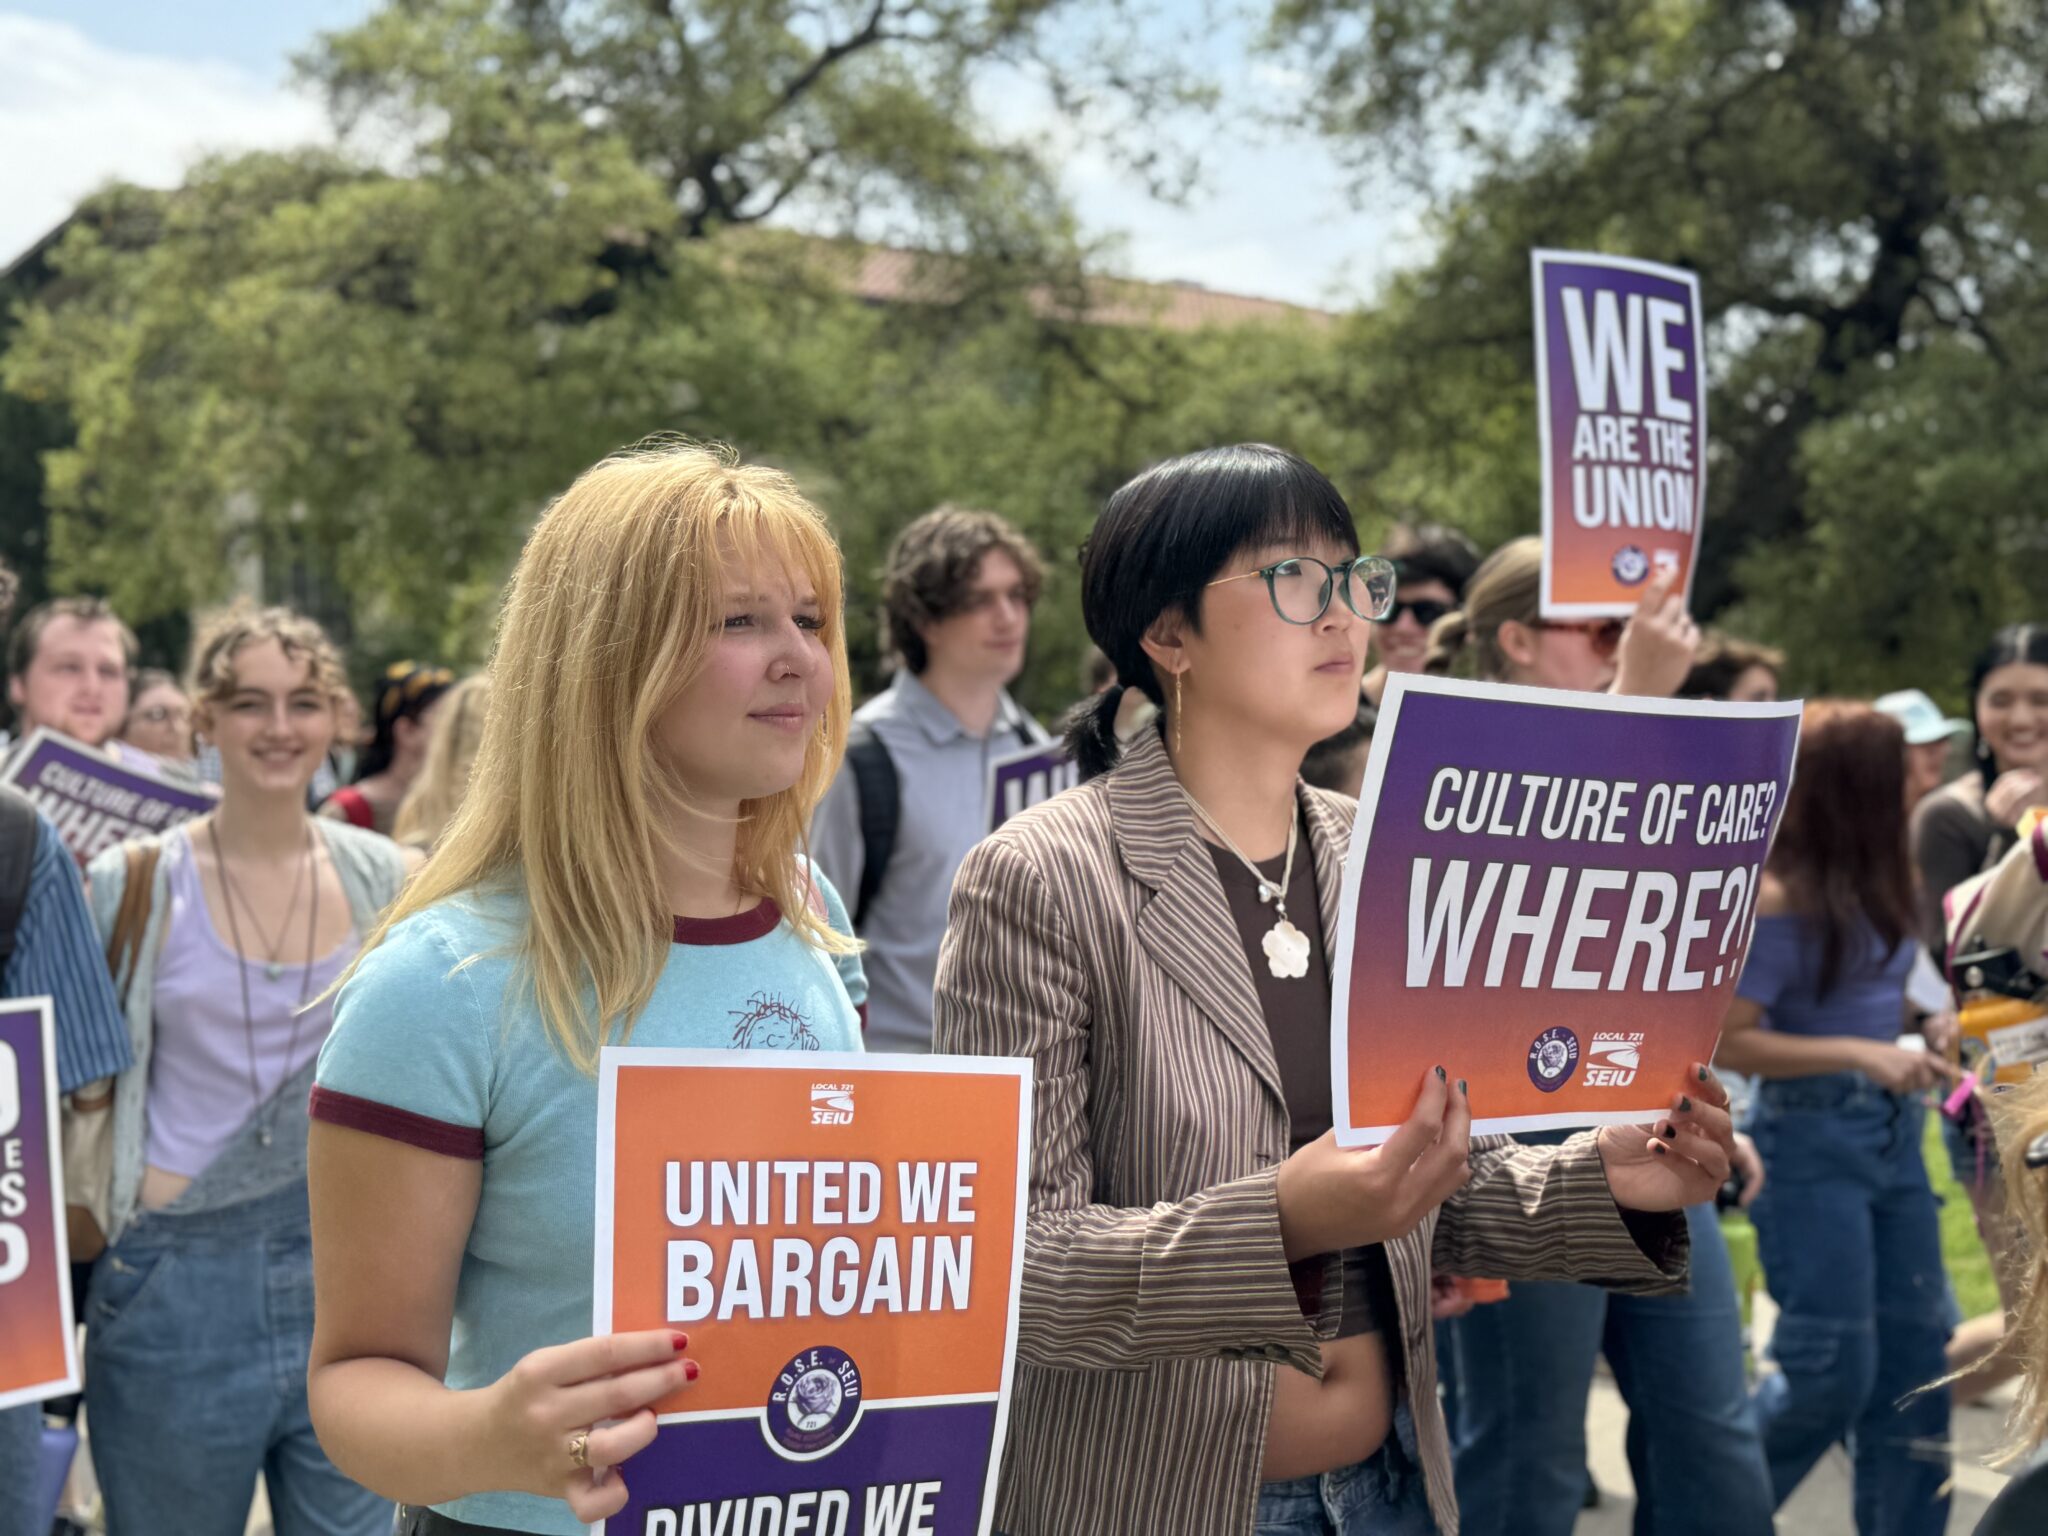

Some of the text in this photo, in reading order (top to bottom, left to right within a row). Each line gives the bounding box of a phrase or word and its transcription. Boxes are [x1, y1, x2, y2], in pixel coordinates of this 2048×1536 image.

[1561, 286, 1692, 421] WE
[1572, 414, 1692, 469] ARE THE
[1572, 464, 1693, 535] UNION
[1424, 767, 1777, 845] CULTURE OF CARE?
[1406, 857, 1759, 991] WHERE?!
[1566, 1036, 1577, 1059] SEIU
[1593, 1032, 1644, 1040] LOCAL 721
[1583, 1070, 1636, 1086] SEIU
[811, 1111, 854, 1125] SEIU
[666, 1161, 977, 1226] UNITED WE
[667, 1235, 972, 1322] BARGAIN
[838, 1361, 858, 1397] SEIU
[864, 1481, 941, 1536] WE
